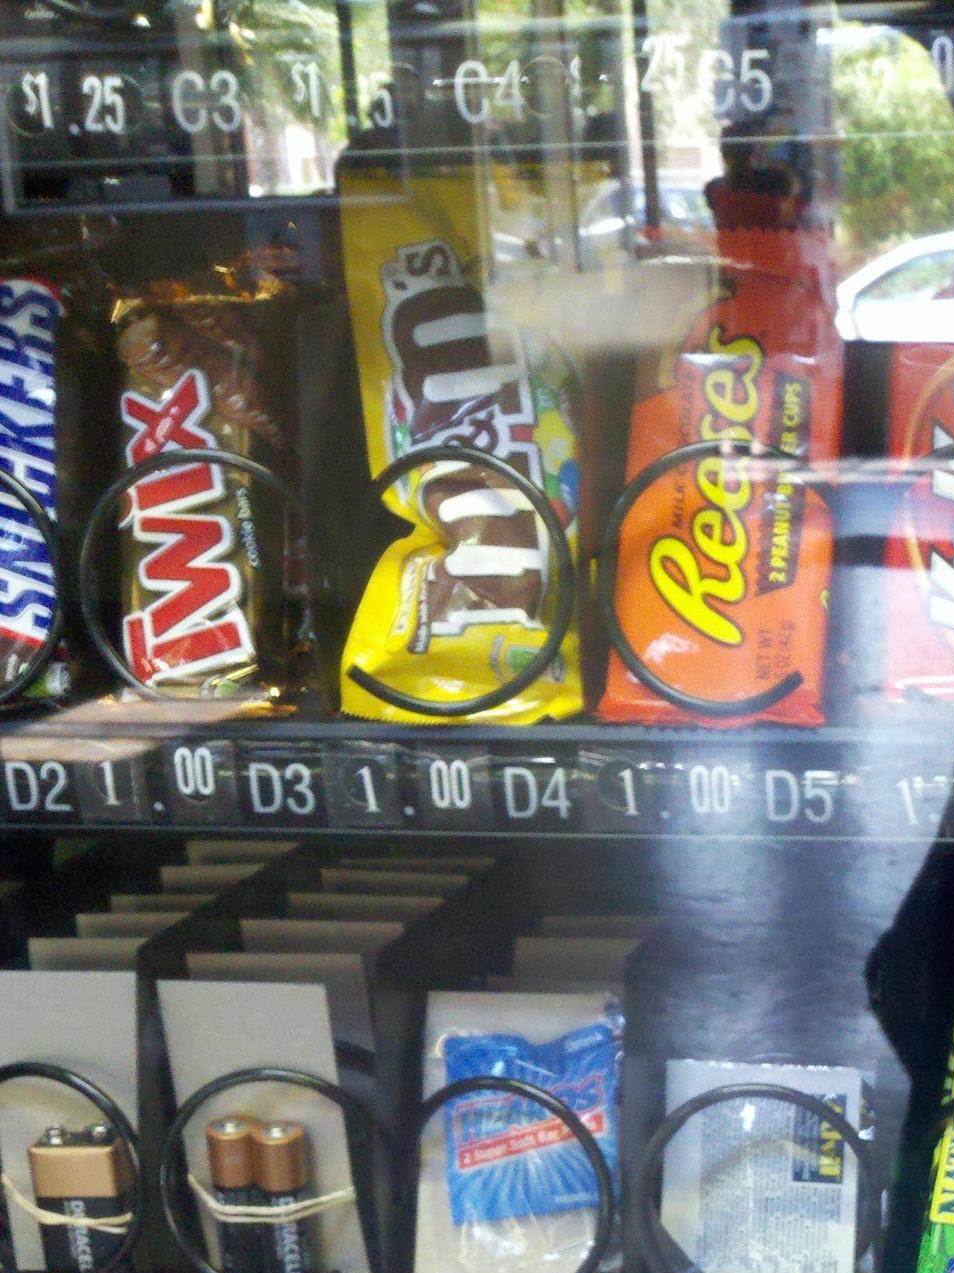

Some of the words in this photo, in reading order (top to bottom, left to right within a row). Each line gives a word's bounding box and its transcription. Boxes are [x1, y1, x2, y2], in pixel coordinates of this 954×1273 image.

[171, 69, 243, 133] C3
[120, 367, 255, 687] TWIX
[4, 760, 72, 813] D2
[247, 762, 317, 815] D3
[503, 766, 573, 820] D4
